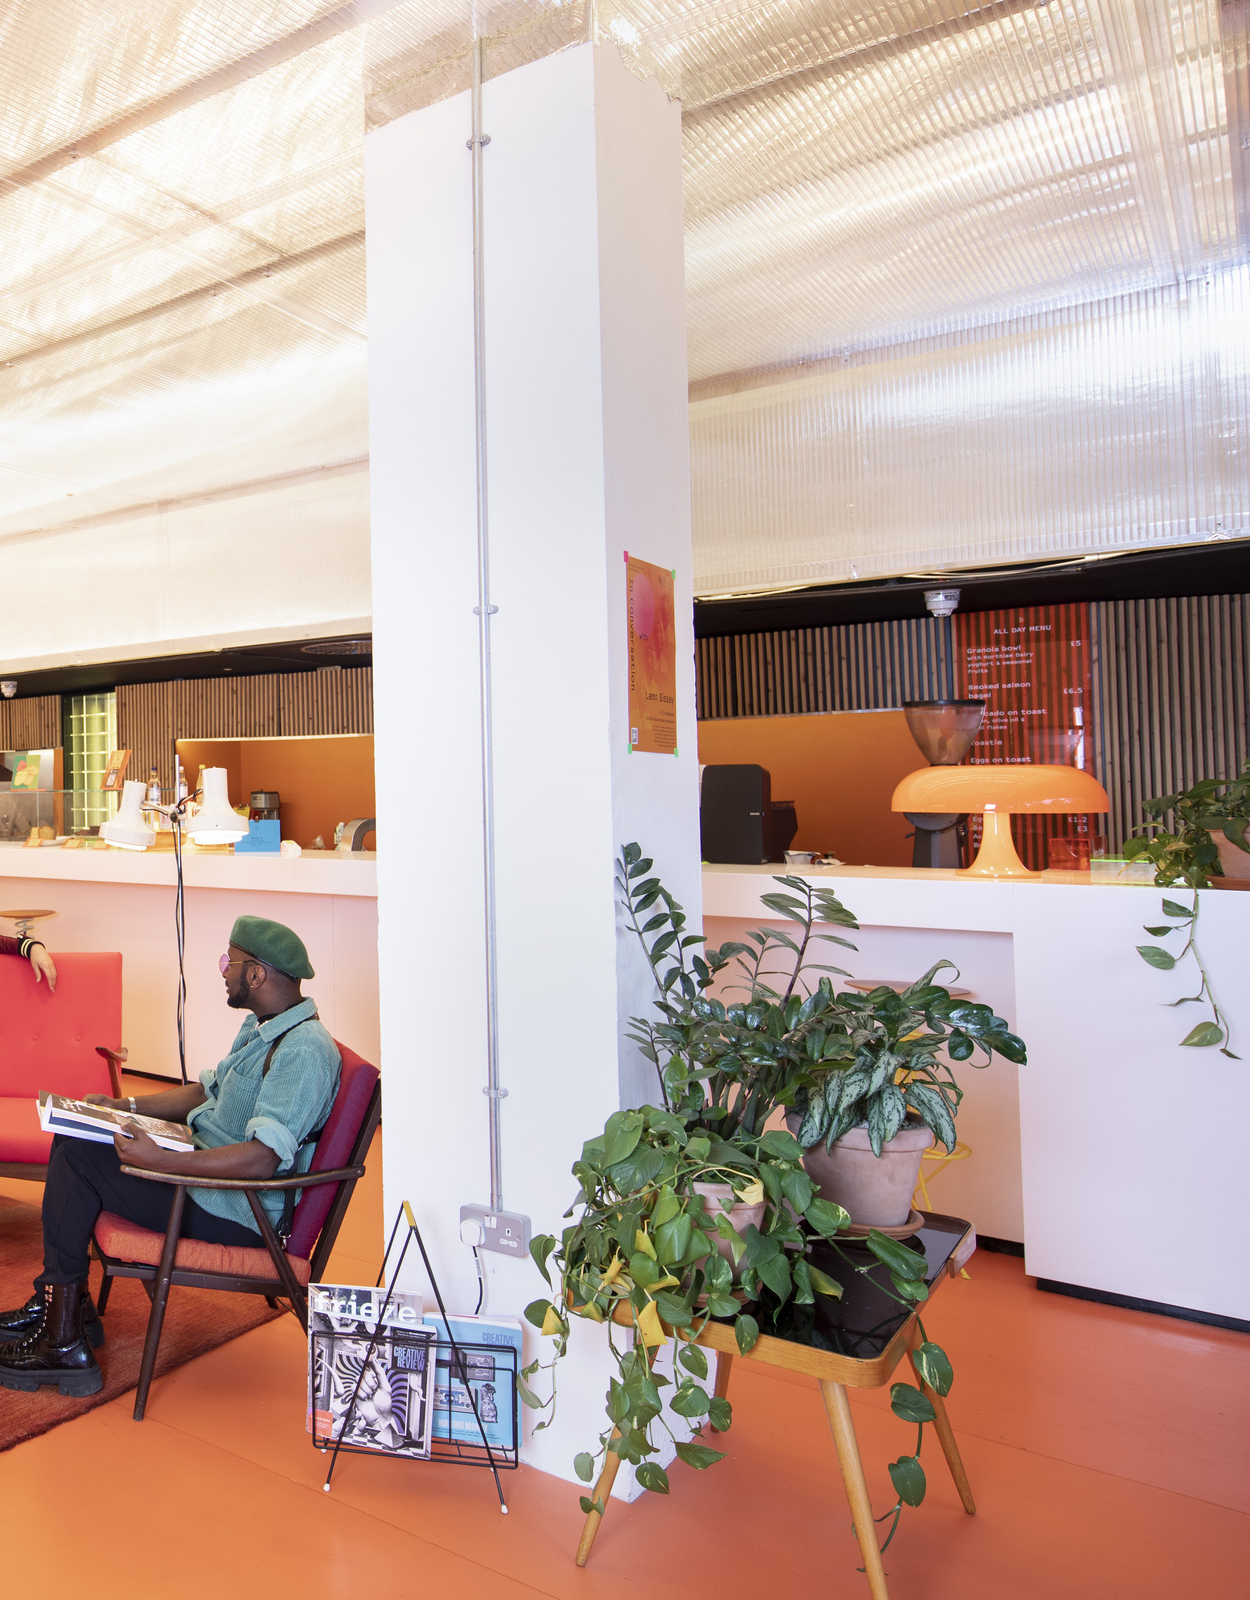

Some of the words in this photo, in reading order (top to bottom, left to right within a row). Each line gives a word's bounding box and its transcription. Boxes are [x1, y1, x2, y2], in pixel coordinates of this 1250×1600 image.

[629, 578, 634, 592] In
[1011, 626, 1027, 634] DAY
[967, 646, 999, 654] Granola
[1001, 644, 1021, 652] bowl
[968, 683, 1000, 691] Smoked
[1063, 687, 1083, 695] £6.5
[659, 692, 674, 706] Sissay
[968, 692, 992, 700] bagel
[970, 757, 990, 765] Eggs
[314, 1290, 417, 1324] frieze
[482, 1332, 515, 1346] CREATIVE
[393, 1346, 426, 1361] CREATIVE
[397, 1356, 425, 1371] REVIEW
